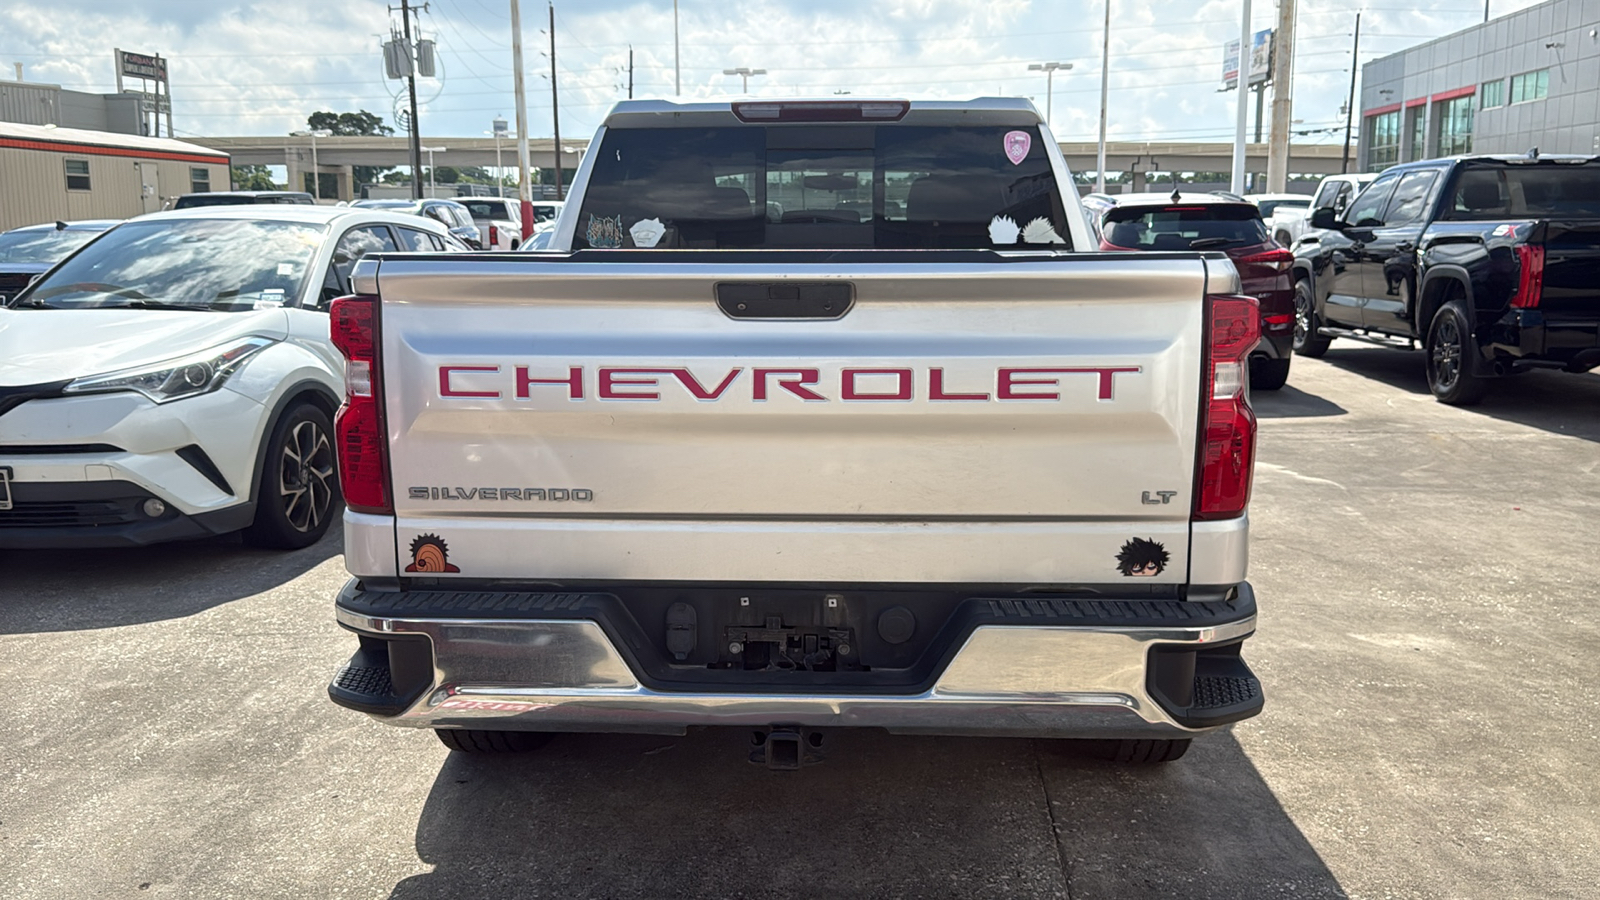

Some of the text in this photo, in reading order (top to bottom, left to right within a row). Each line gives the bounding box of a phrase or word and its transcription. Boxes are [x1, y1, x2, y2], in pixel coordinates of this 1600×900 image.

[438, 365, 1141, 401] CHEVROLET
[408, 486, 594, 502] SILVERADO
[1141, 490, 1178, 505] LT
